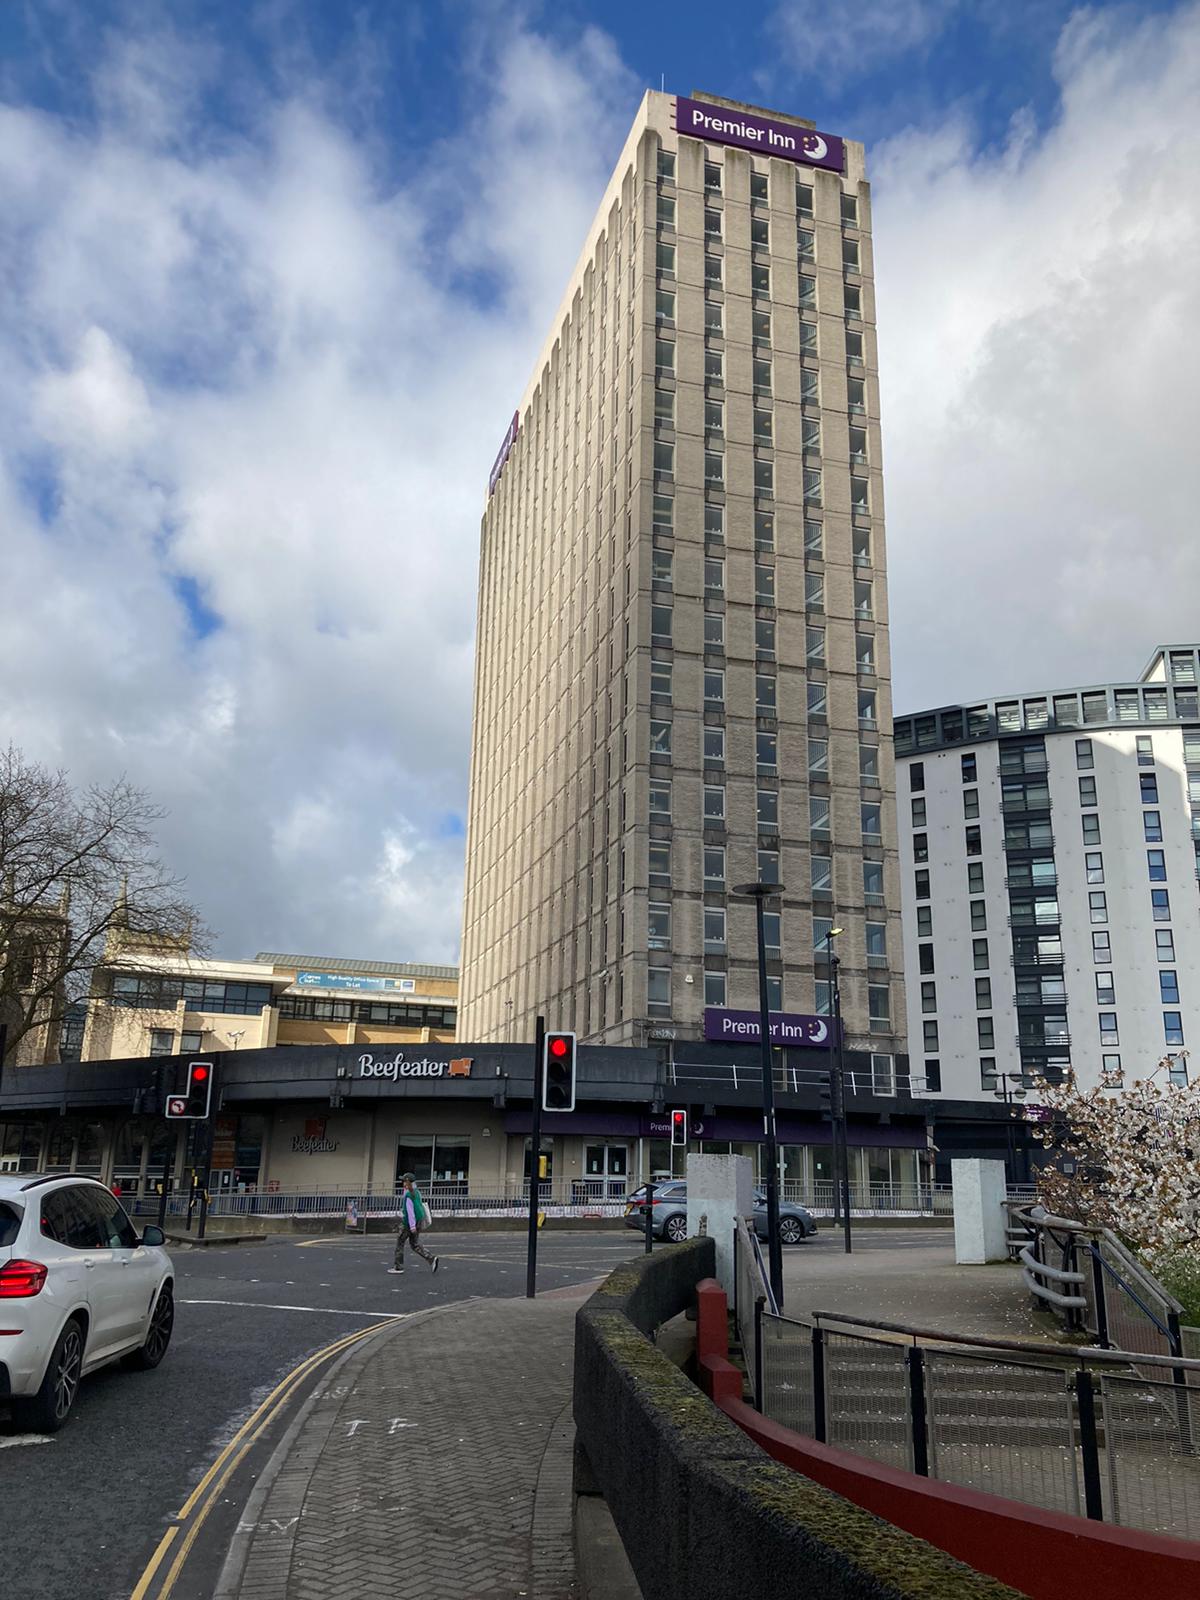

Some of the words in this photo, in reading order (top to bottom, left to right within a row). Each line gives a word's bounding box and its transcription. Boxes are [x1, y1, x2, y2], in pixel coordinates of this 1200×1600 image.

[692, 109, 765, 142] Premier
[769, 129, 796, 150] Inn
[722, 1018, 779, 1036] Premer
[781, 1022, 803, 1038] Inn
[358, 1052, 448, 1081] Beefeater
[290, 1135, 340, 1156] Beefeater
